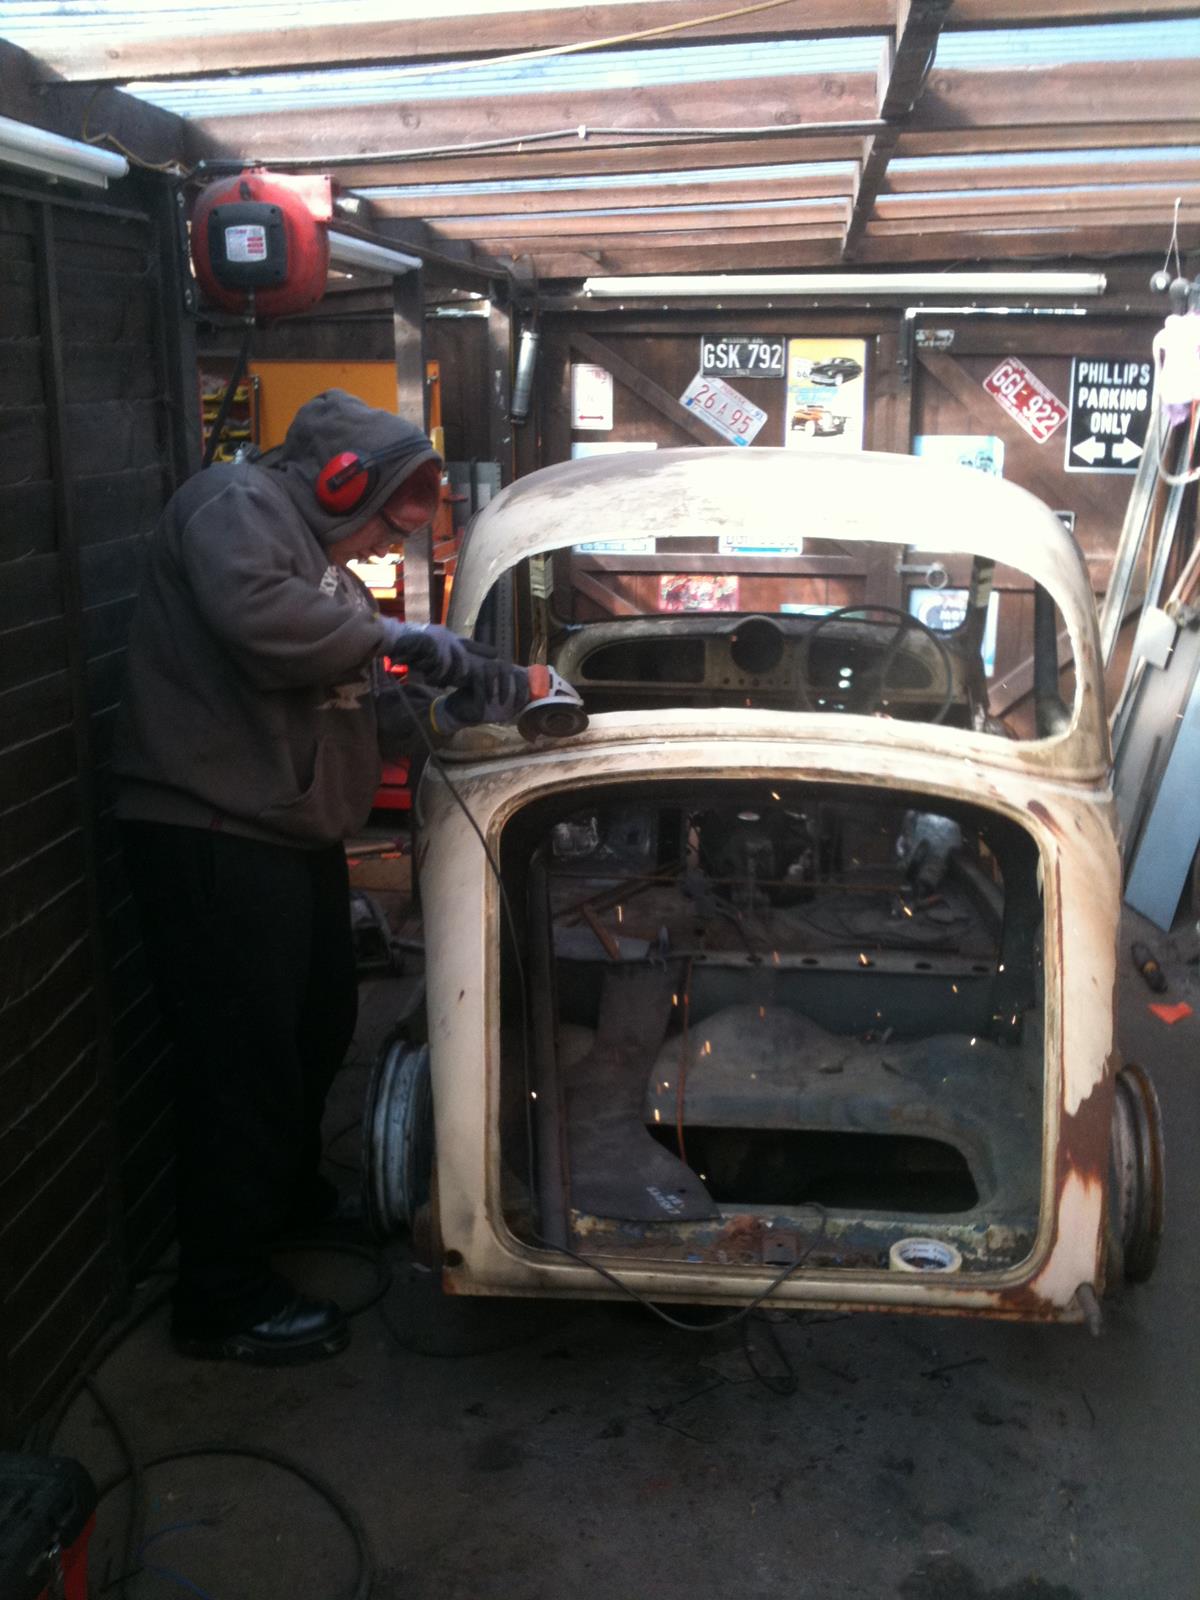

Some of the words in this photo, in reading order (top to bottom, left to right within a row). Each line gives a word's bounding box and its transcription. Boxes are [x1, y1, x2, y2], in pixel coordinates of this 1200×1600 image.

[704, 343, 740, 369] GSK
[747, 344, 782, 369] 792
[1078, 362, 1150, 386] PHILLIPS
[694, 384, 717, 409] 26
[729, 410, 753, 434] 95
[1078, 387, 1148, 411] PARKING
[1022, 396, 1060, 434] 922
[1090, 412, 1131, 435] ONLY
